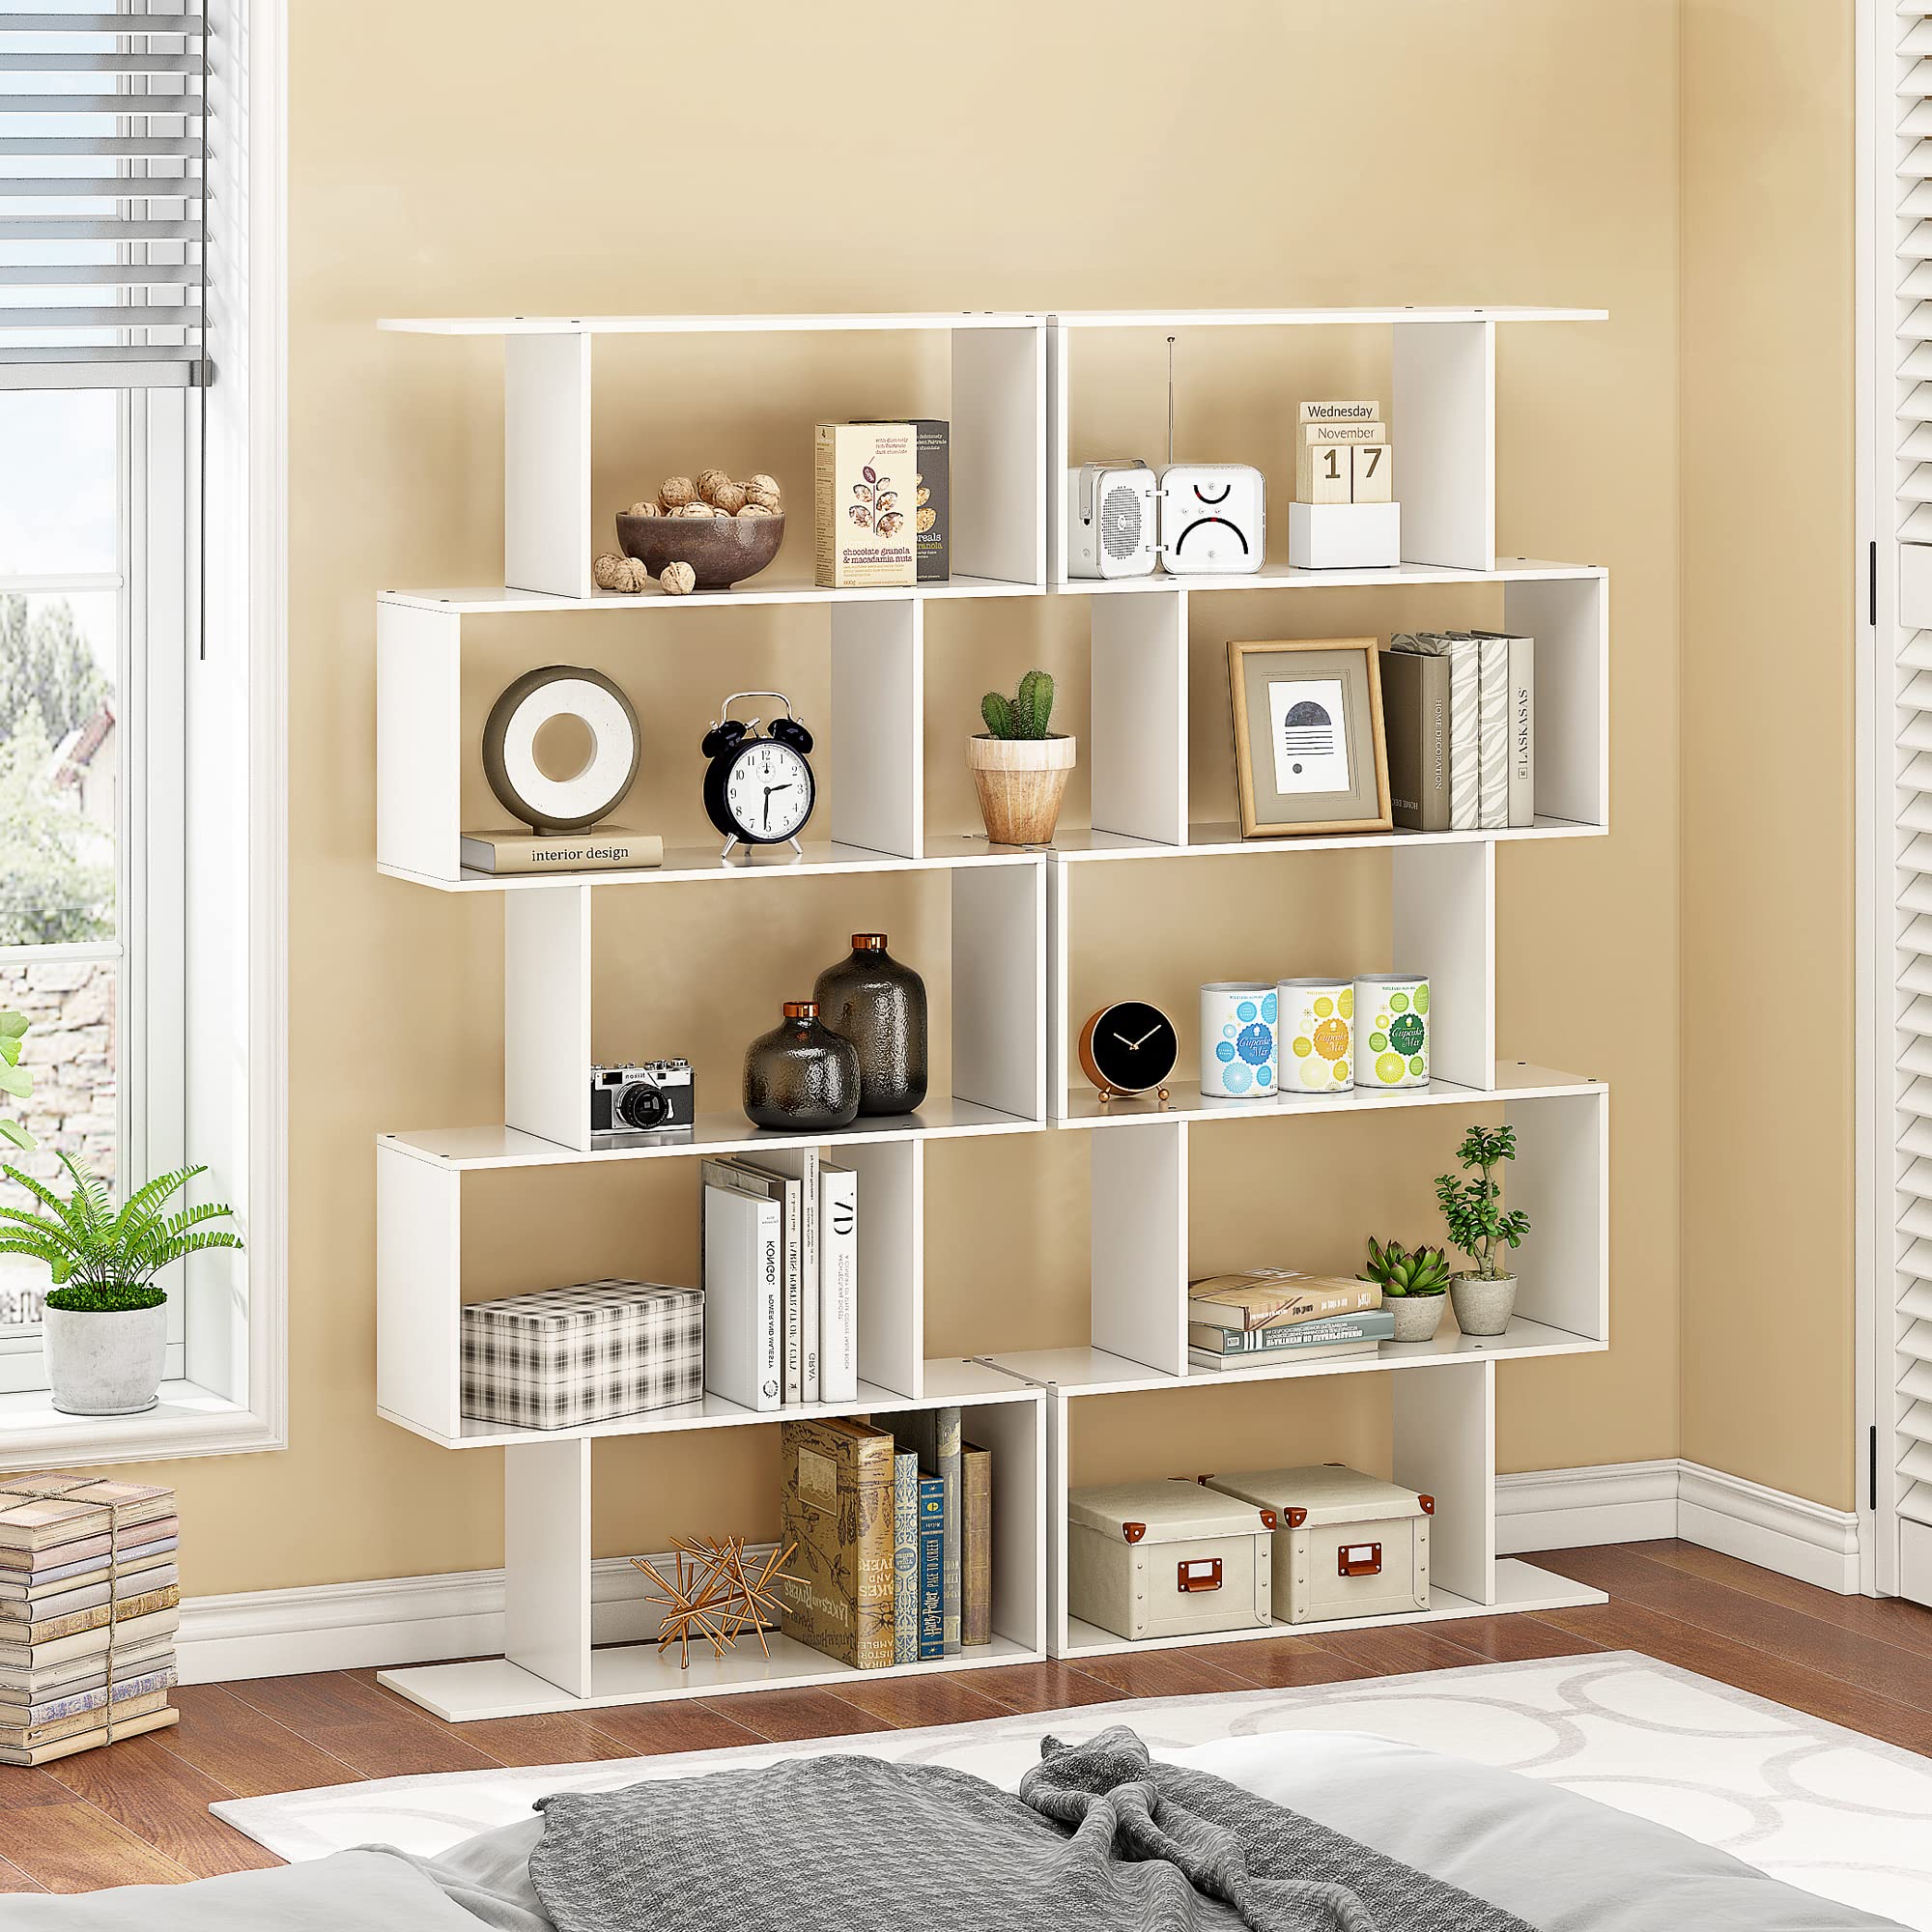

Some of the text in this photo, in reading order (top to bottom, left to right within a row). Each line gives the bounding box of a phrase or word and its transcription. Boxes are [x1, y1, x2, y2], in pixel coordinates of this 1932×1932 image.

[1307, 405, 1374, 419] Wednesday
[1318, 427, 1376, 440] November
[1323, 448, 1382, 479] 1 7
[918, 532, 942, 542] reals
[843, 548, 879, 556] chocolate
[880, 547, 910, 557] granola
[851, 555, 895, 564] macadamia
[1519, 688, 1528, 764] LASKASAS
[531, 845, 629, 863] interior design
[1239, 1037, 1271, 1049] Cupcake
[926, 1539, 939, 1562] SCREEN
[926, 1563, 939, 1572] TO
[868, 1572, 891, 1584] AND
[926, 1573, 939, 1588] PAGE
[783, 1579, 813, 1610] RIVERS
[858, 1583, 895, 1600] AKES
[922, 1591, 944, 1615] Potter
[822, 1597, 849, 1628] LAKES
[923, 1614, 943, 1637] Harry
[858, 1639, 895, 1650] AMBLE
